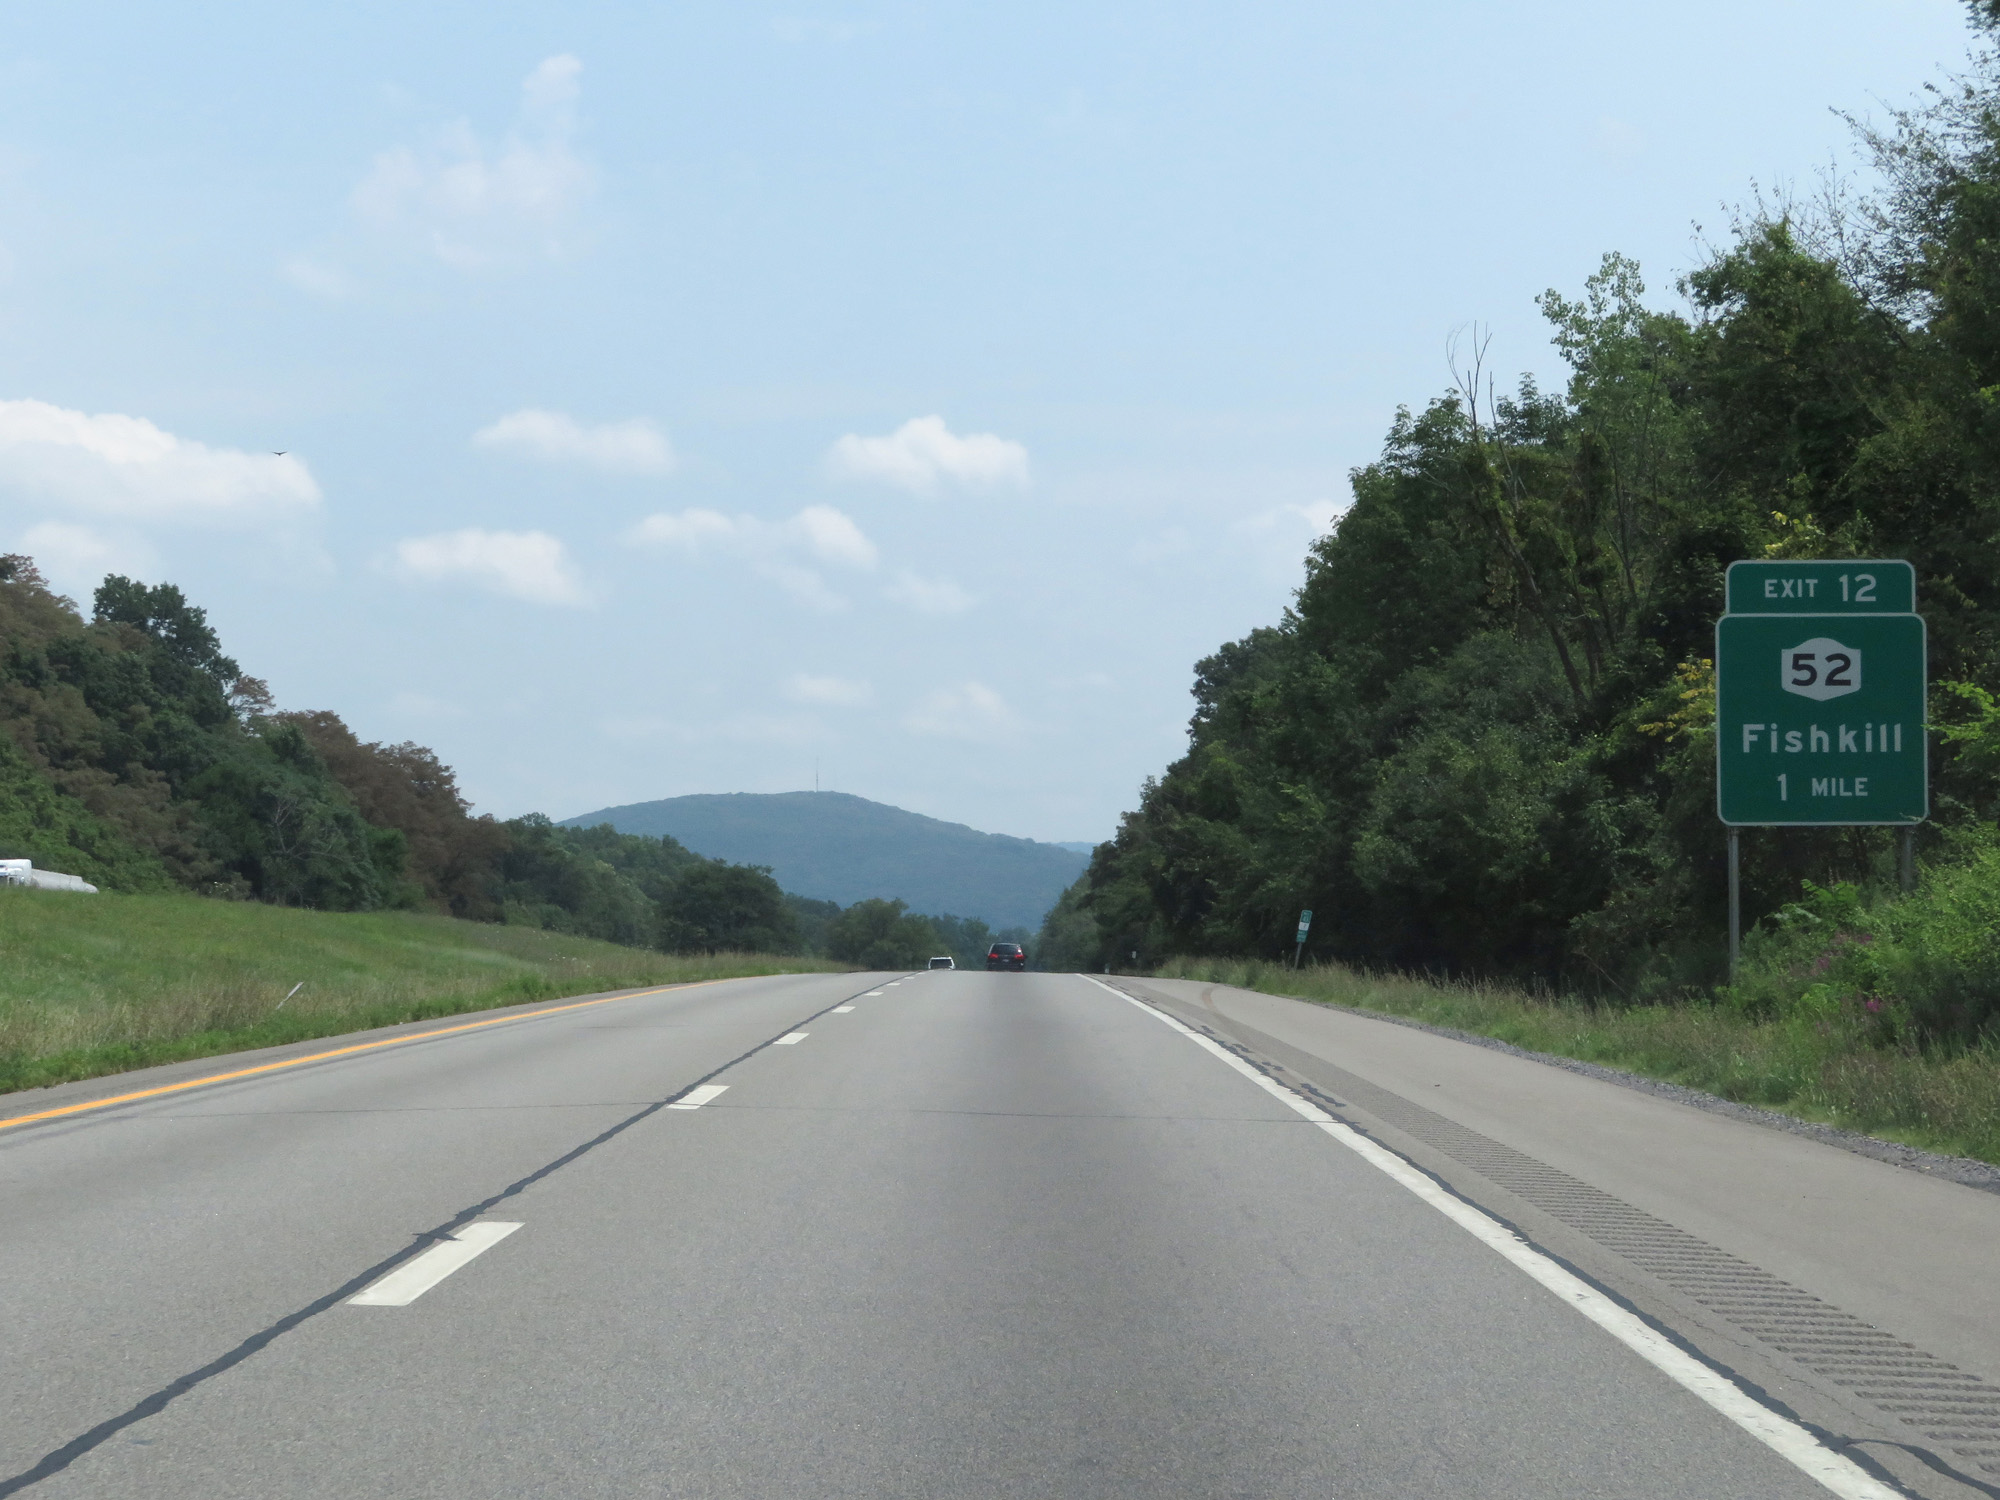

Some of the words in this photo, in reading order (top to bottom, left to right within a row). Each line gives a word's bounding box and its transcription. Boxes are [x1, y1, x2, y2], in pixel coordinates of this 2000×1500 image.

[1764, 578, 1819, 598] EXIT
[1838, 574, 1877, 602] 12
[1791, 653, 1852, 687] 52
[1742, 723, 1902, 754] Fishkill
[1776, 774, 1787, 801] 1
[1811, 778, 1868, 797] MILE
